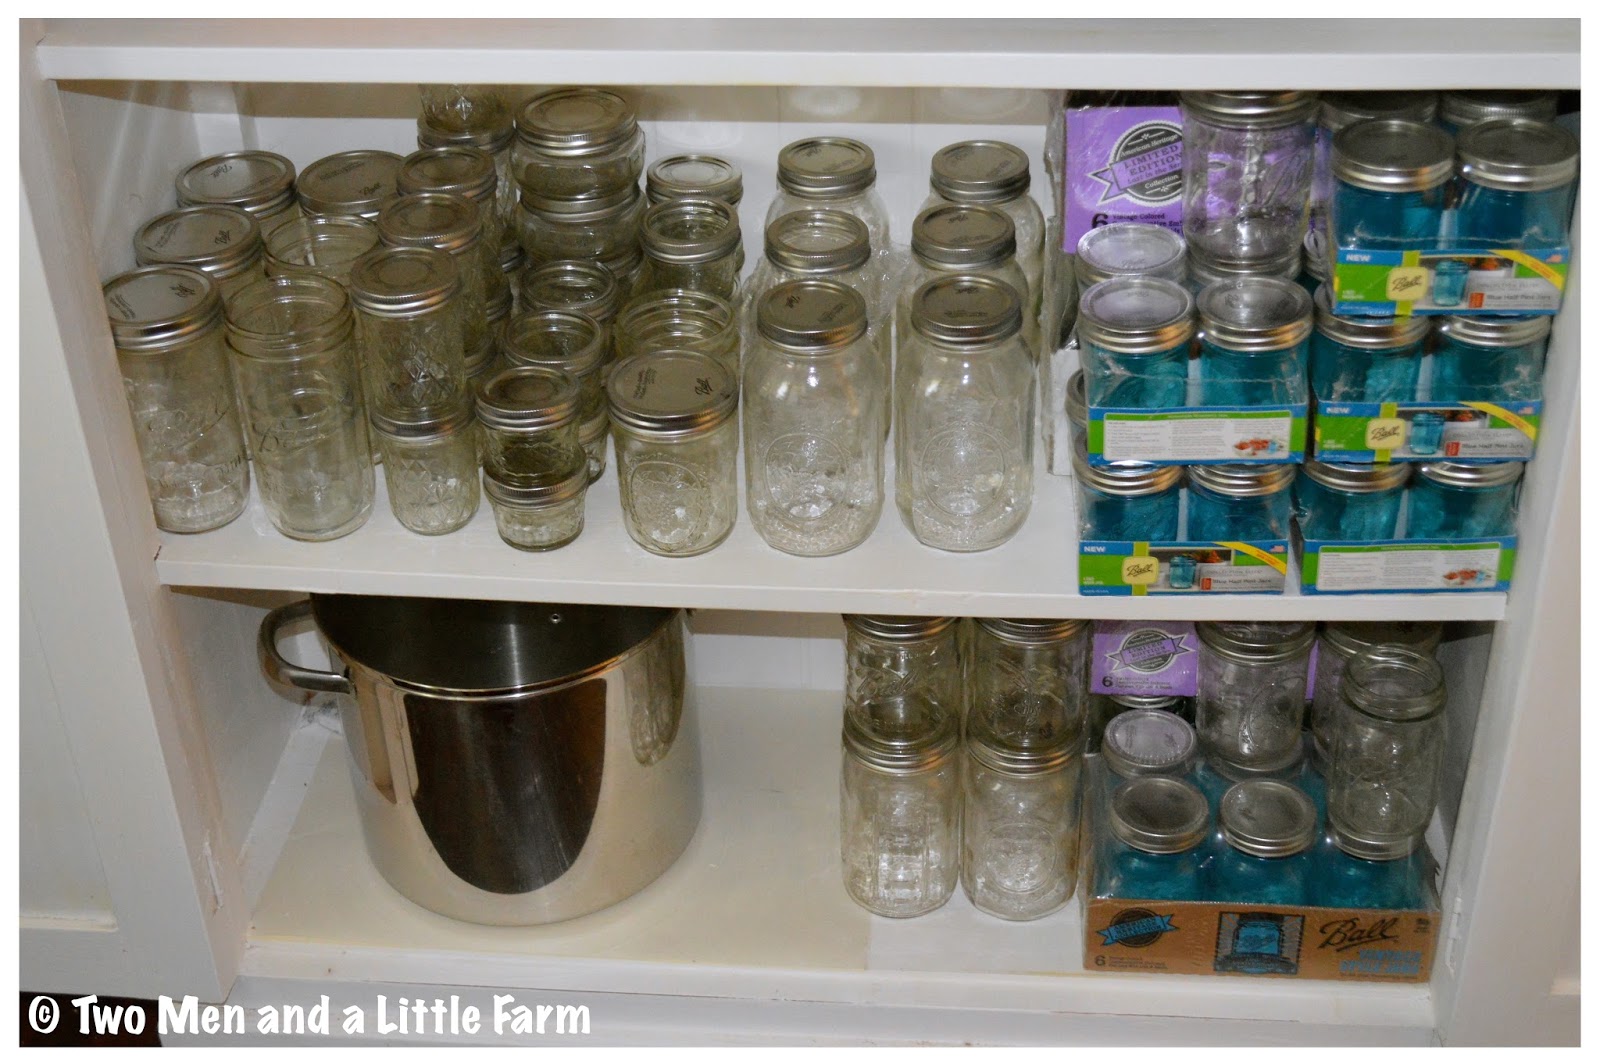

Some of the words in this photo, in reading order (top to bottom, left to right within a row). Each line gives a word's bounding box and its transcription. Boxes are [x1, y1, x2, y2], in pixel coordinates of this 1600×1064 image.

[1151, 134, 1178, 147] Heritage
[1124, 145, 1178, 169] LIMITED
[1144, 174, 1179, 189] Collection
[1345, 254, 1371, 262] NEW
[1391, 275, 1423, 292] Ball
[1370, 425, 1400, 441] Ball
[1126, 563, 1154, 577] Ball
[1102, 676, 1113, 688] 6
[1318, 917, 1399, 952] Ball
[1094, 955, 1106, 967] 6
